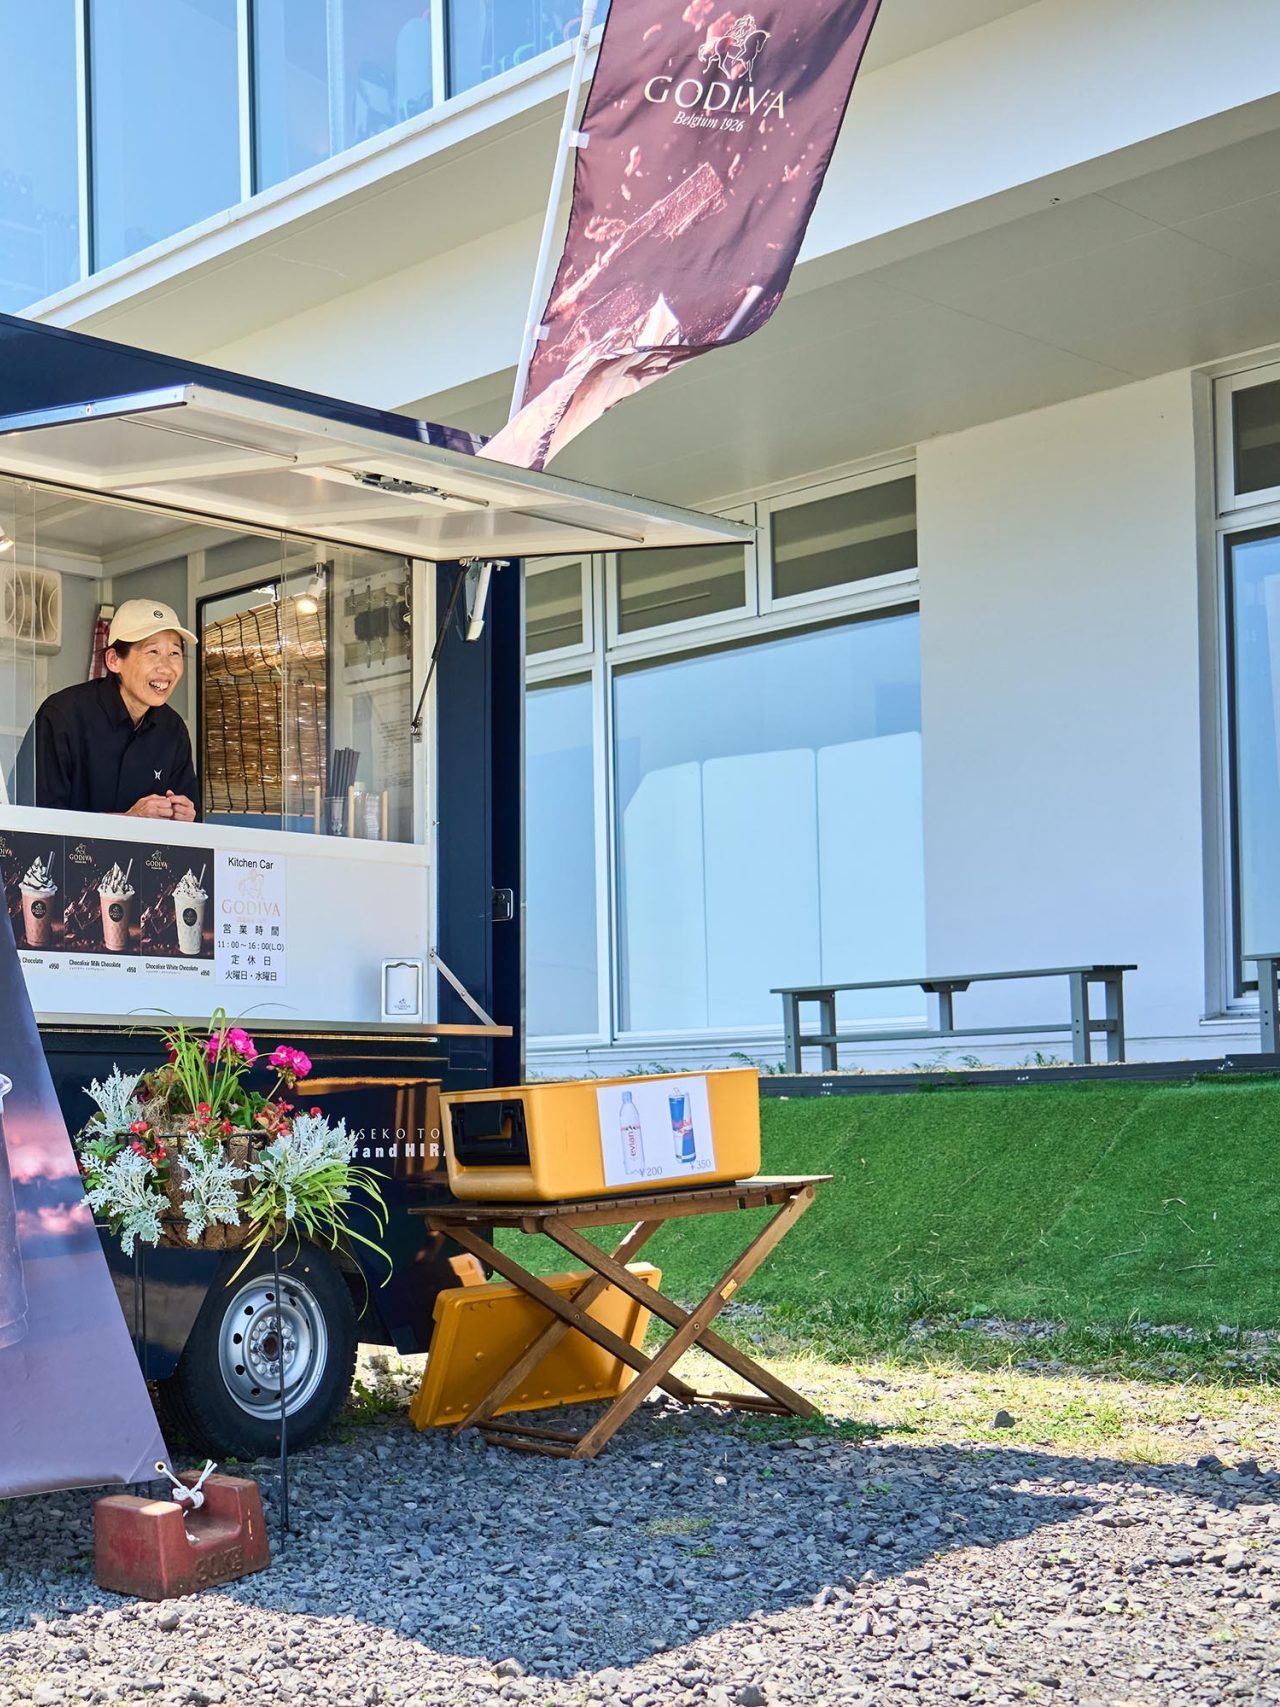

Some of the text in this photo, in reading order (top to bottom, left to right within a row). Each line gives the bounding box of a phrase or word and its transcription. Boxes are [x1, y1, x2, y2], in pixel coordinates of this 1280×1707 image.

[644, 76, 785, 119] GODIVA
[673, 111, 745, 133] Belgium 1926
[228, 857, 274, 869] Kitchen Car
[222, 899, 280, 917] GODIVA
[223, 923, 280, 937] 営業時間
[231, 954, 272, 966] 定休日
[225, 970, 277, 981] 火曜日・水曜日
[349, 1128, 406, 1140] SEKO
[347, 1143, 447, 1158] rand HIR
